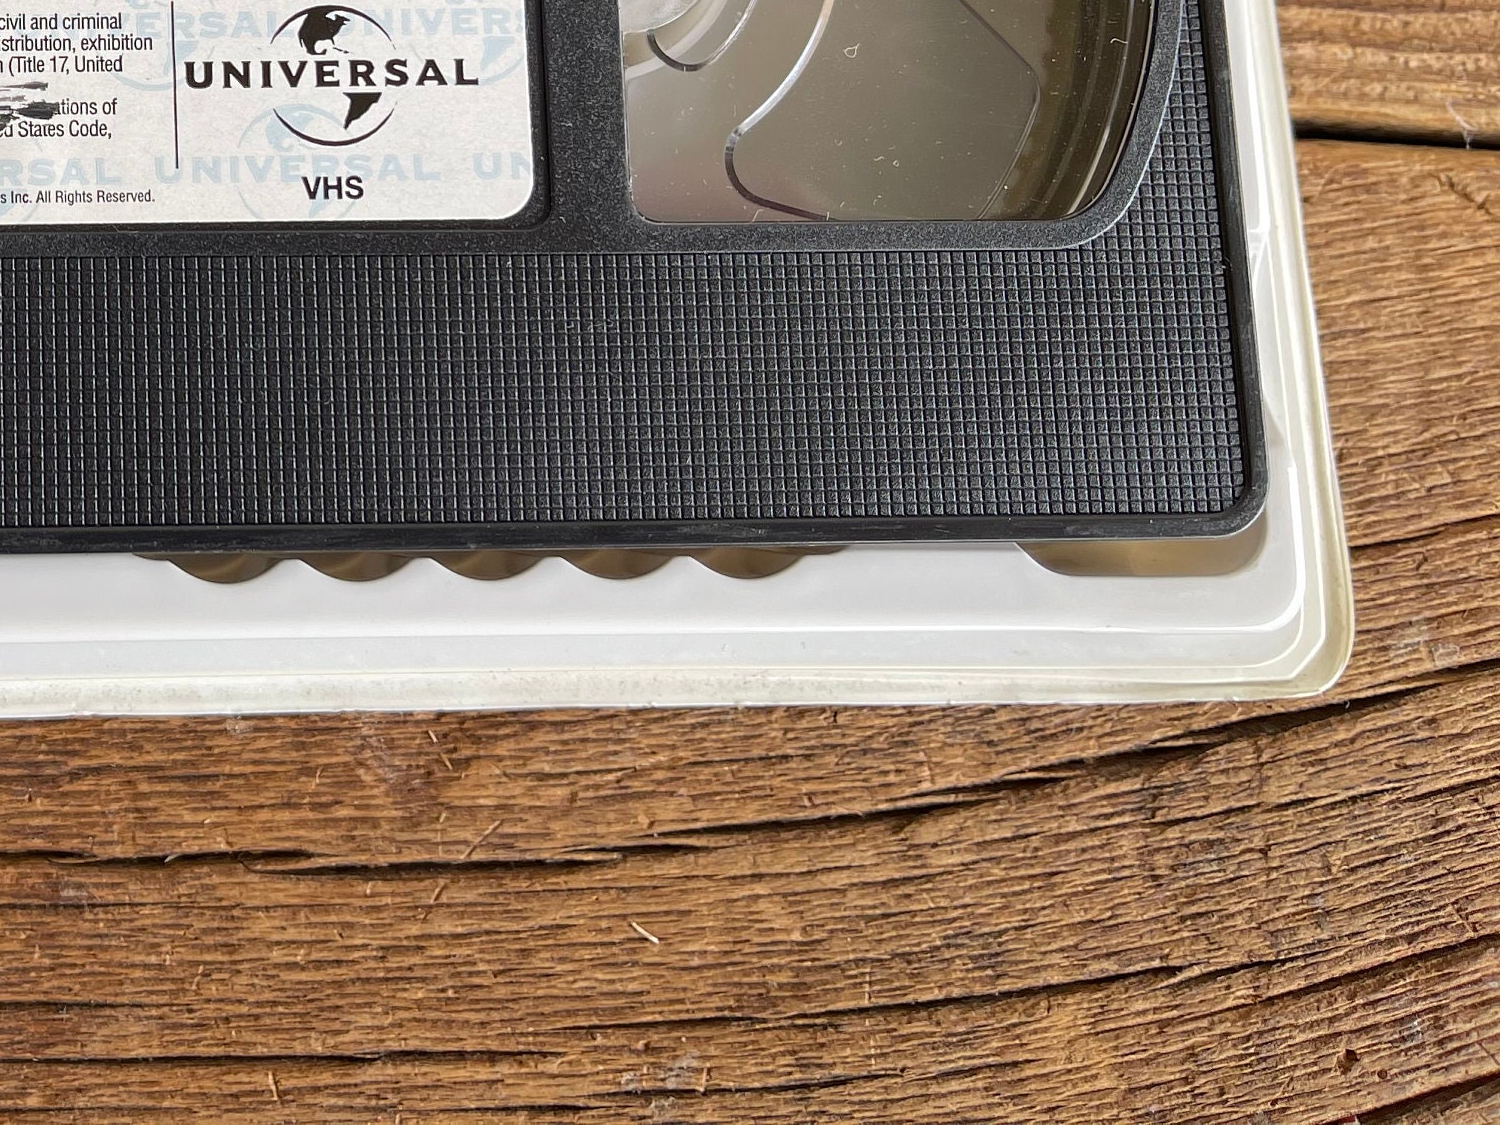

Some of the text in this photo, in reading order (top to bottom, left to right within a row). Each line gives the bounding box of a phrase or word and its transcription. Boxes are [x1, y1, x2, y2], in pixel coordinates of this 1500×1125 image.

[30, 13, 58, 30] and
[62, 12, 122, 30] criminal
[80, 34, 153, 52] exhibition
[8, 56, 45, 76] (Title
[49, 57, 70, 75] 17,
[74, 55, 123, 73] United
[184, 58, 480, 89] UNIVERSAL
[103, 98, 118, 115] of
[18, 121, 65, 138] States
[69, 119, 112, 139] Code,
[11, 190, 33, 204] Inc.
[36, 189, 52, 203] All
[55, 189, 93, 206] Rights
[96, 189, 156, 203] Reserved.
[301, 175, 364, 201] VHS
